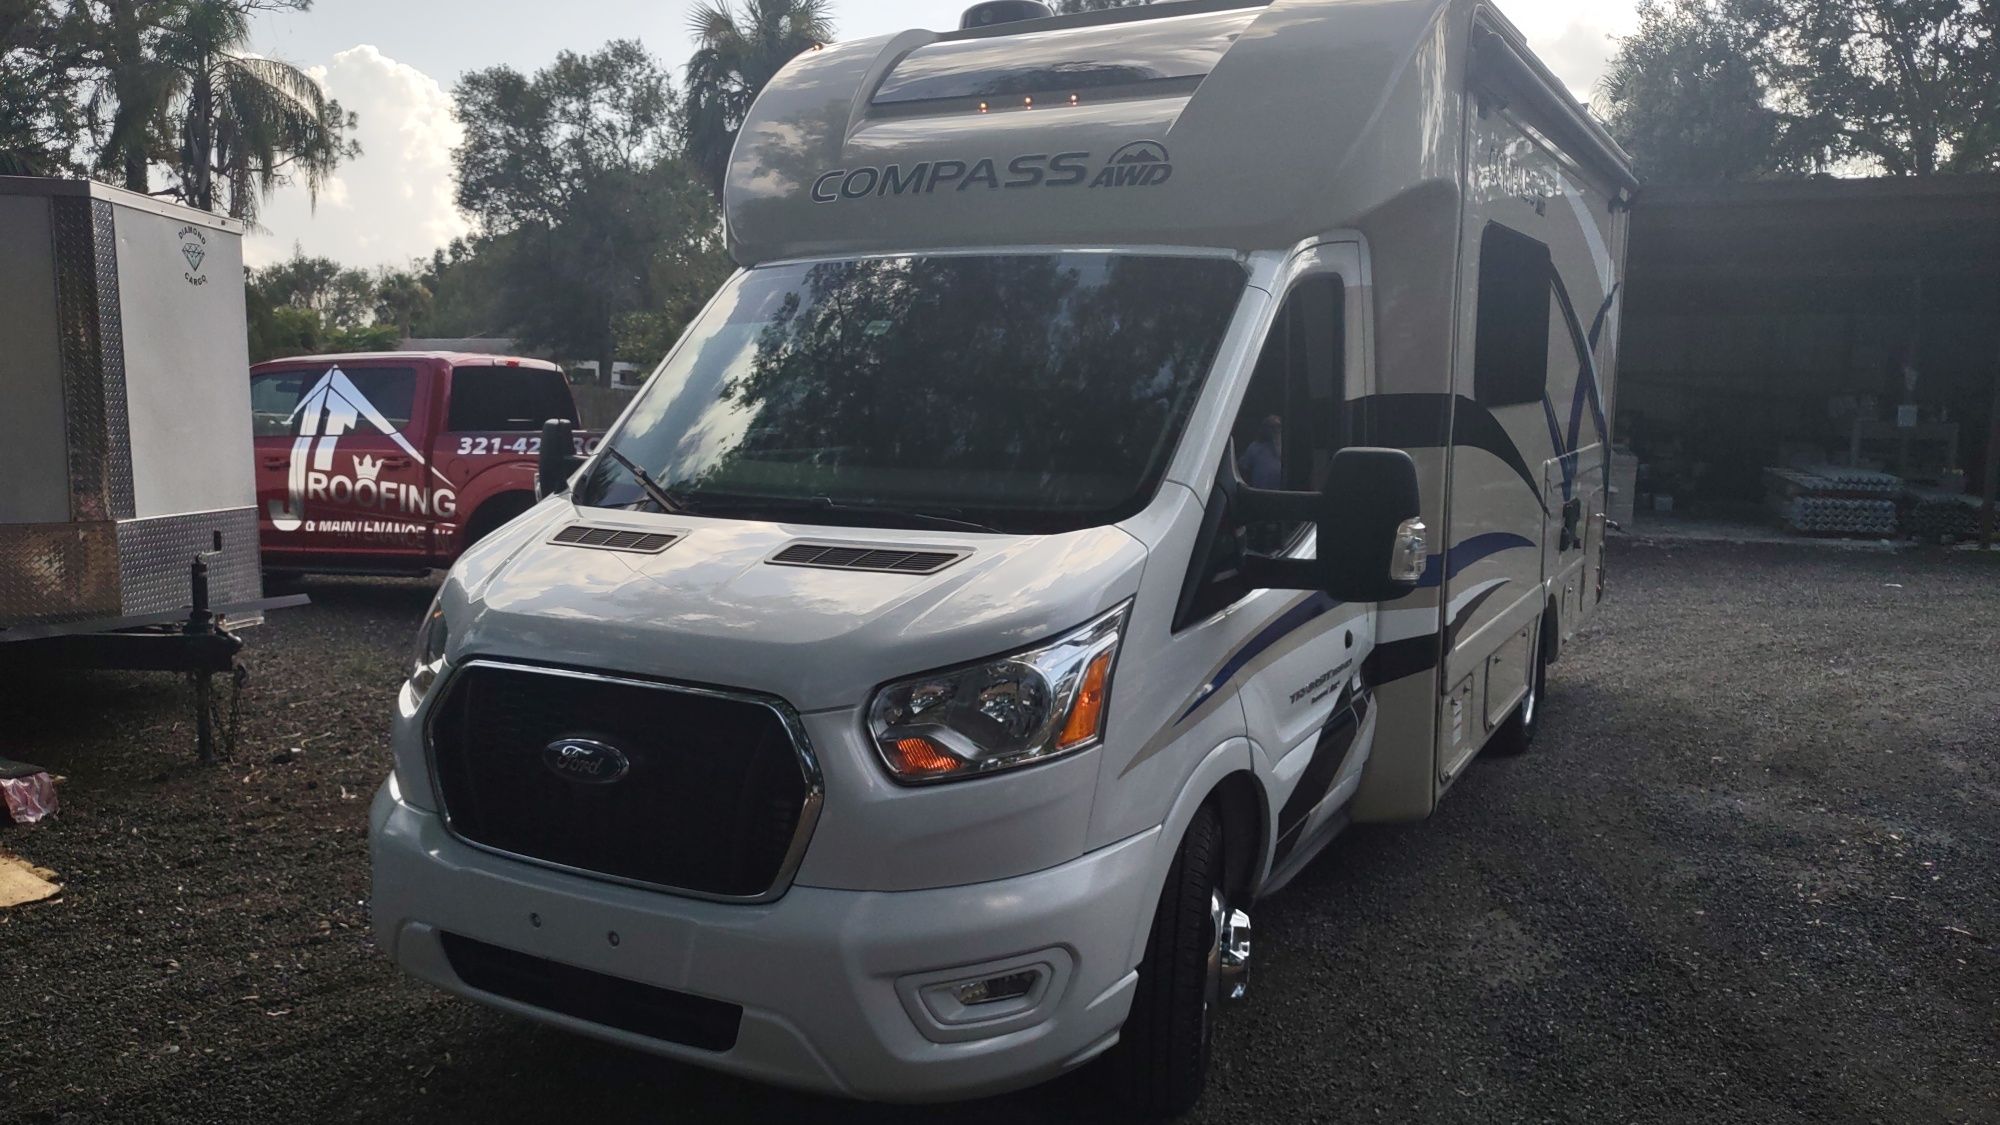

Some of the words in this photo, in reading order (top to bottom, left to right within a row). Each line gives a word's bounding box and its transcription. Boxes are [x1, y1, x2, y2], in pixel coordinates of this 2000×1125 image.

[811, 152, 1087, 204] COMPASS
[1088, 163, 1173, 189] AWD
[178, 228, 206, 245] DIAMOND
[184, 272, 206, 285] CARGO
[308, 470, 456, 518] ROOFING
[318, 519, 427, 547] MAINTENANCE
[556, 745, 604, 775] Ford
